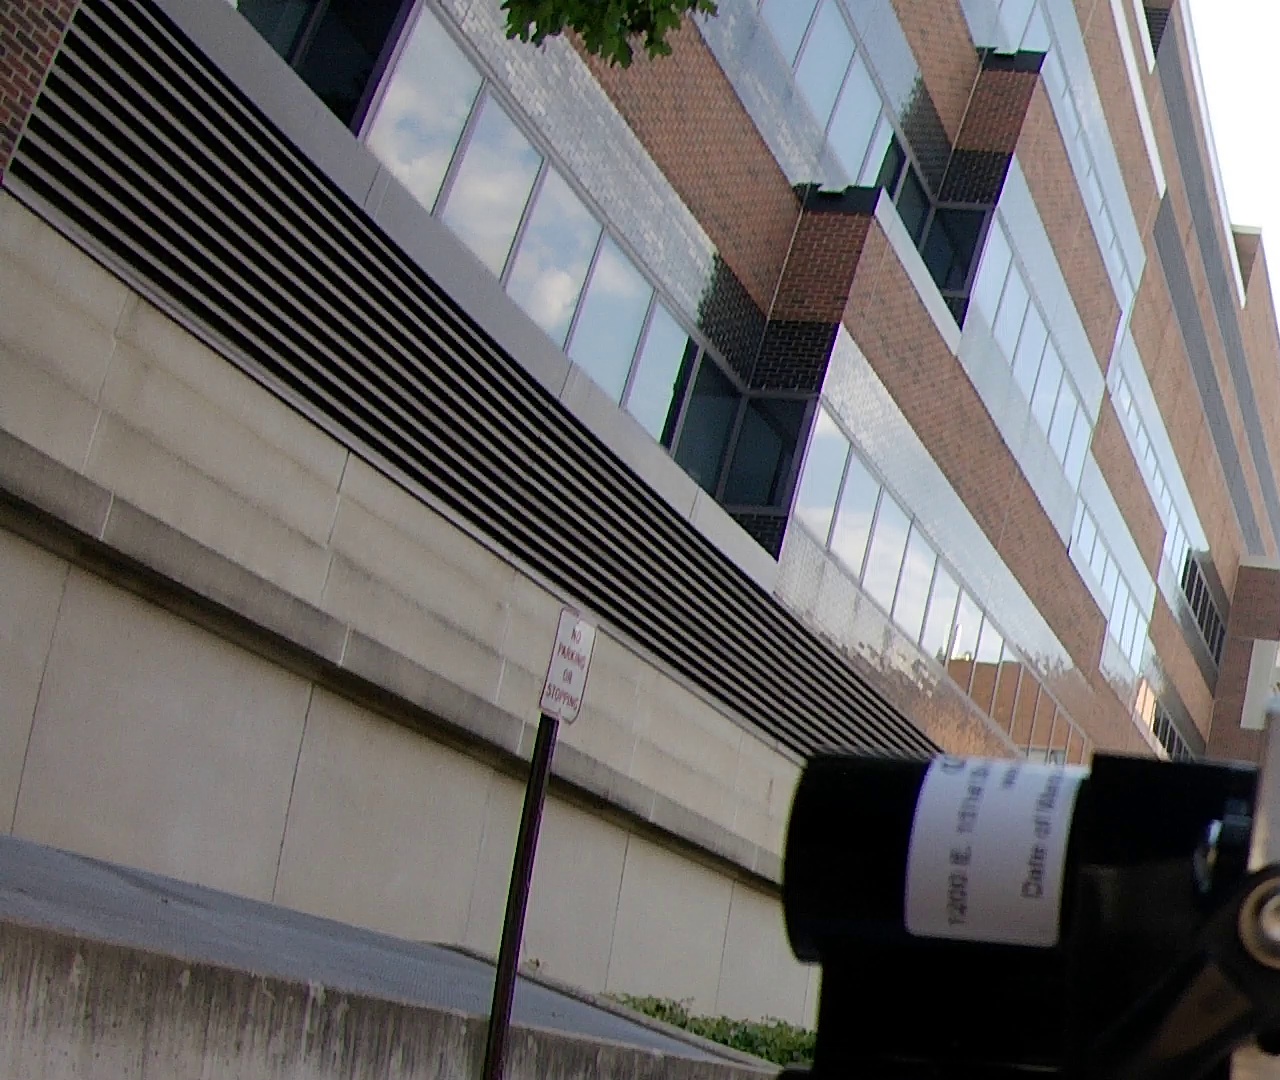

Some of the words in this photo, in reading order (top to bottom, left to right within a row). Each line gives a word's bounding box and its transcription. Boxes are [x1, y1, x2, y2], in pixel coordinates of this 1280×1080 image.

[570, 627, 582, 645] NO
[557, 641, 586, 671] PARKING
[562, 667, 573, 685] OR
[545, 682, 579, 711] STOPPING
